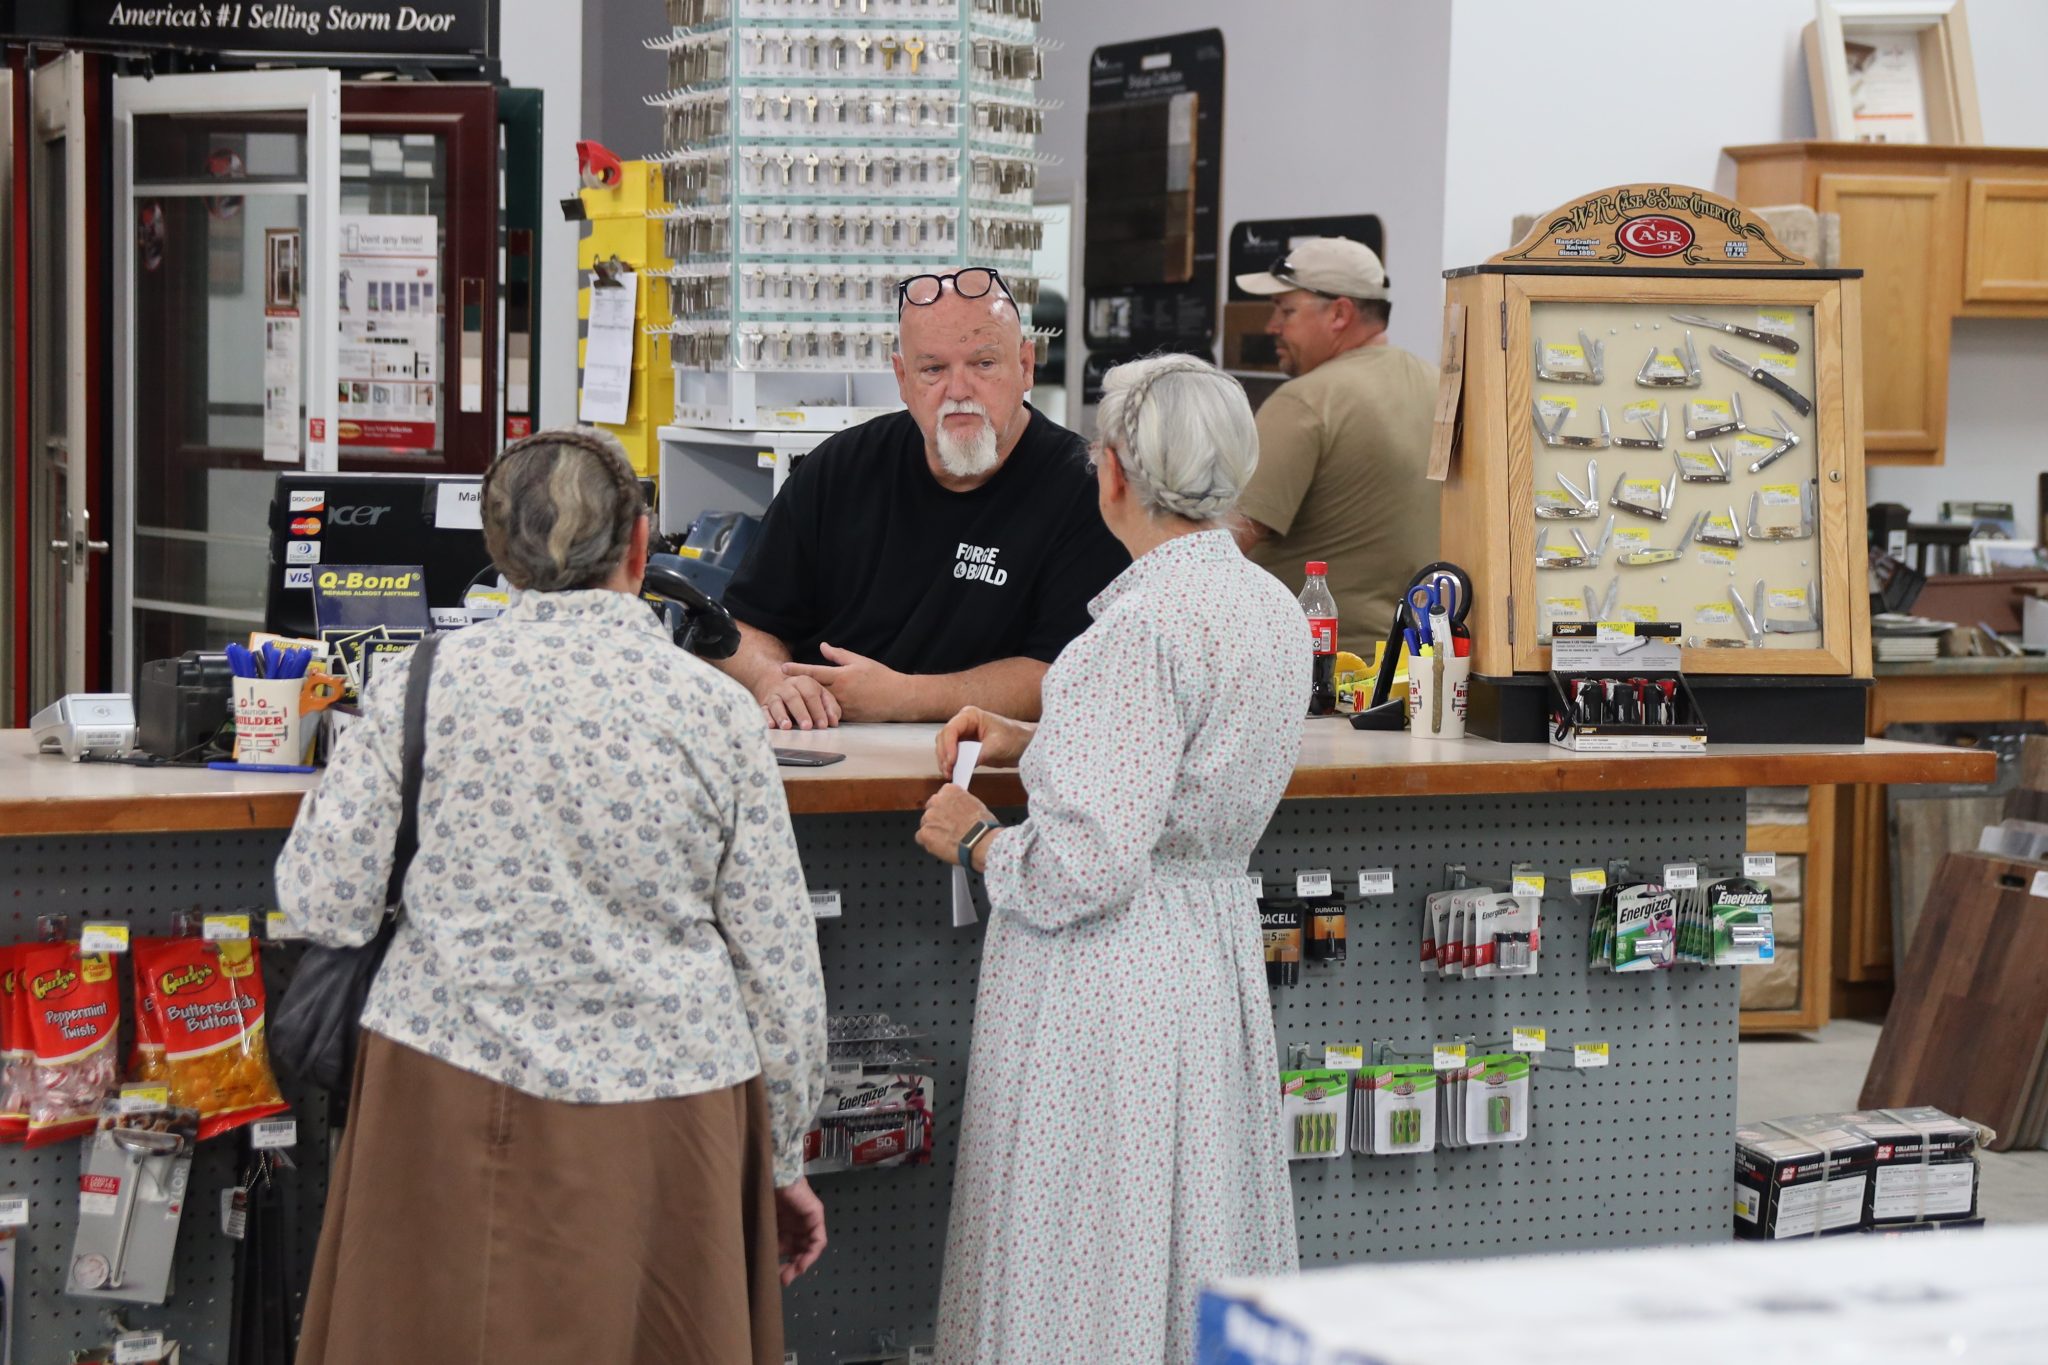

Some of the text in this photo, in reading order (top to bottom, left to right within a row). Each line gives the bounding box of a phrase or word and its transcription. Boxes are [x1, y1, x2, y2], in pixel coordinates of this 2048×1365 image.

[109, 2, 456, 35] America's #1 Selling Storm Door
[955, 542, 1000, 565] FORGE
[965, 563, 1008, 586] BUILD
[1353, 690, 1364, 713] 3M
[1260, 913, 1297, 925] RACELL
[1482, 907, 1509, 920] Energizer
[1619, 896, 1674, 924] Energizer
[1271, 932, 1277, 941] 5
[46, 1002, 107, 1026] Peppermint
[61, 1022, 97, 1040] Twists
[838, 1085, 890, 1110] Energizer
